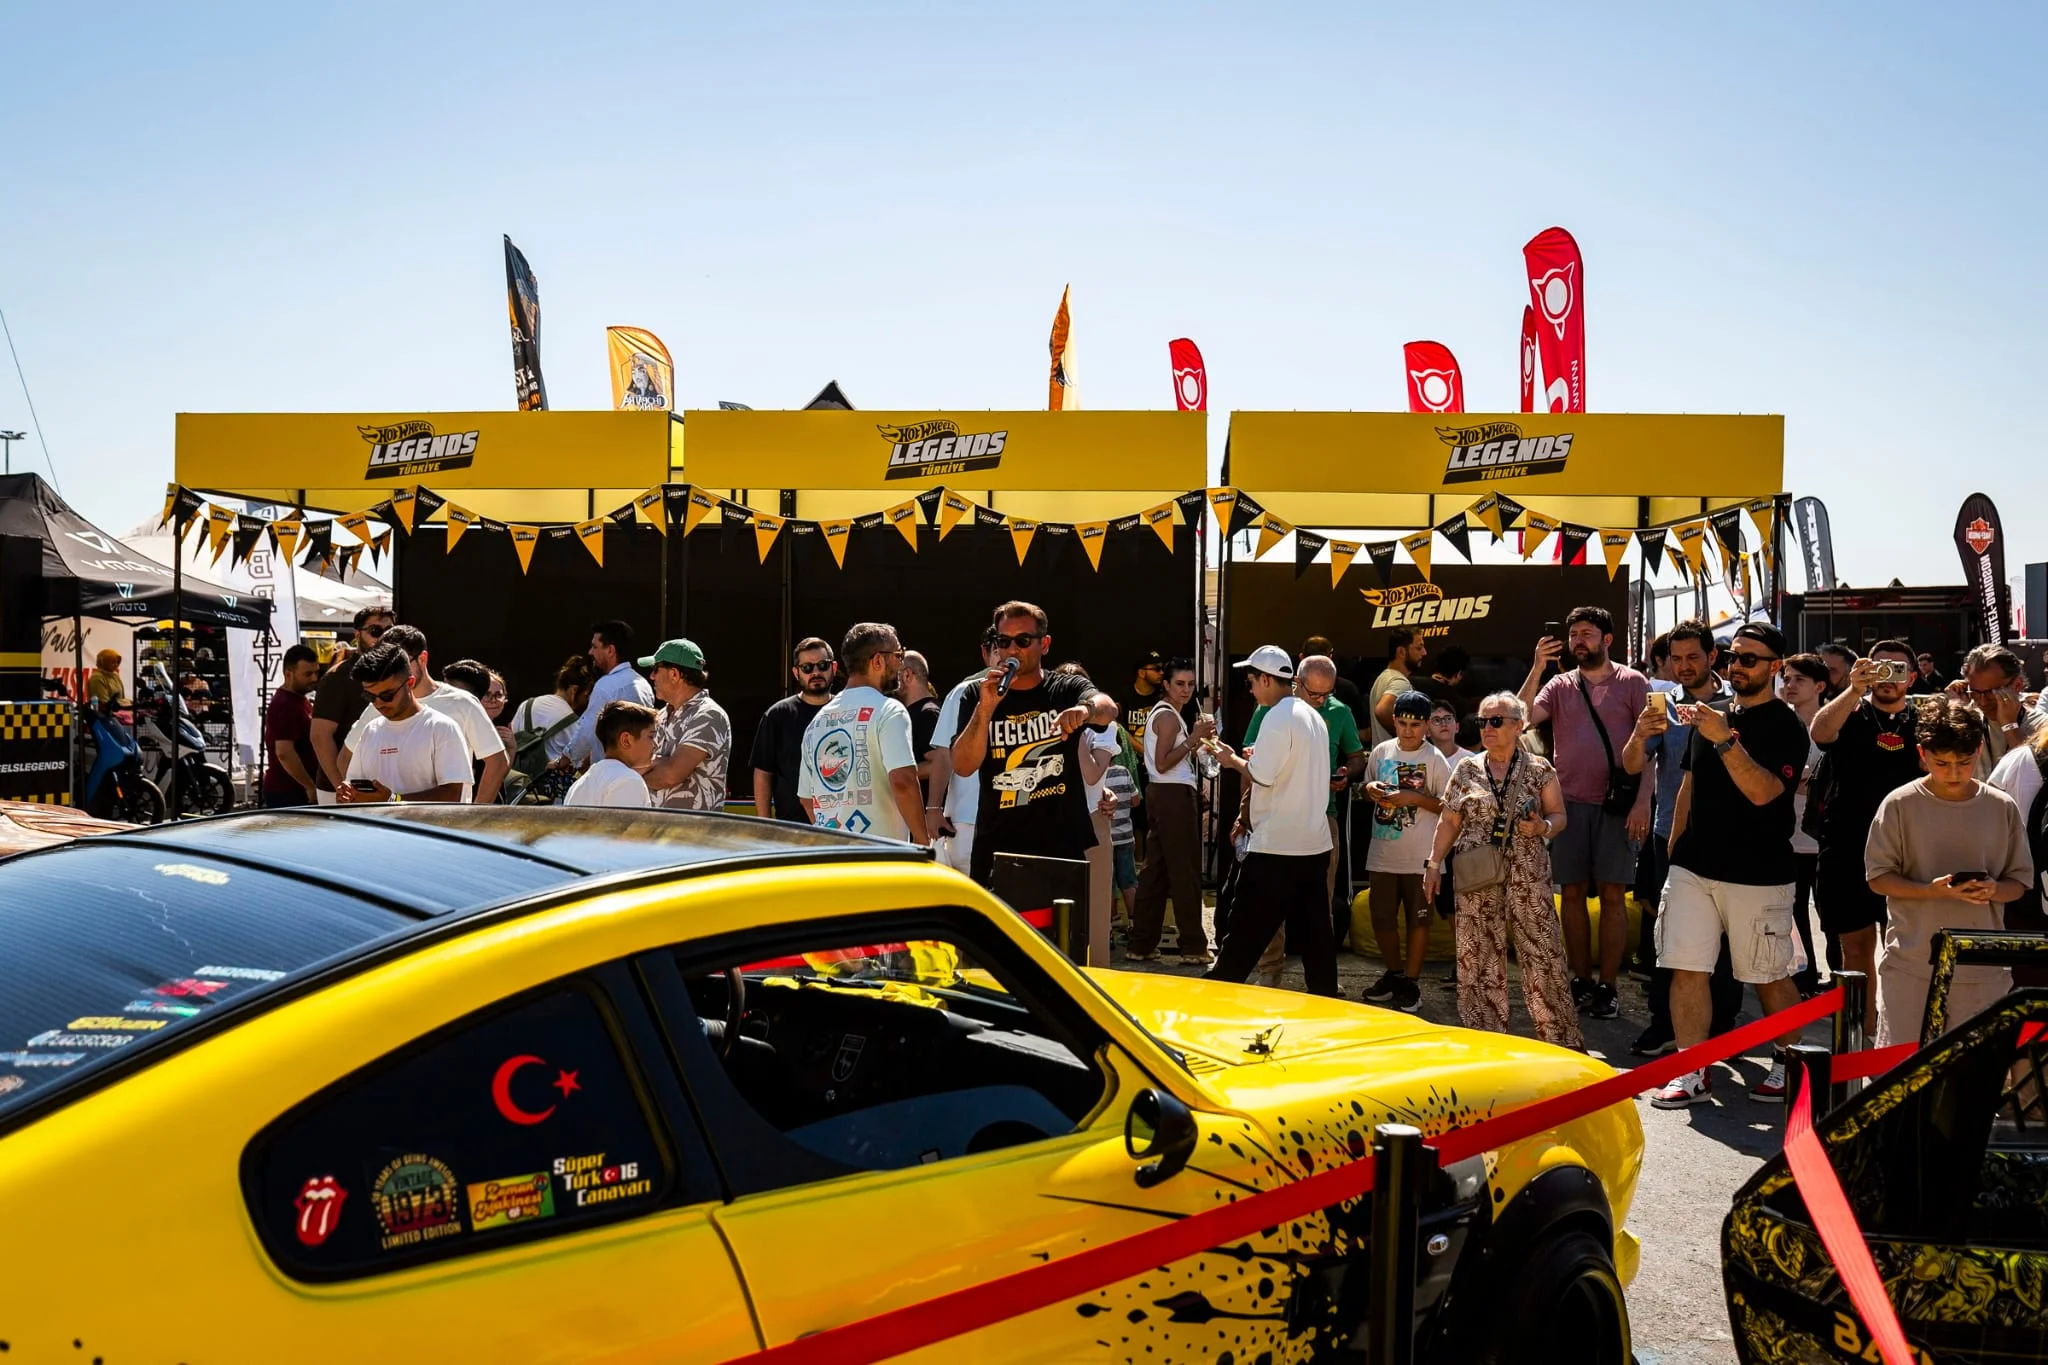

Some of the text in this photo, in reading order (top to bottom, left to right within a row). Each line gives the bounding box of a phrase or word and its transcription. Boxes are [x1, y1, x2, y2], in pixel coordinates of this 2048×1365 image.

[370, 431, 480, 466] LEGENDS
[890, 431, 1008, 466] LEGENDS
[1448, 433, 1574, 469] LEGENDS
[399, 461, 441, 475] TÜRKİYE
[921, 461, 966, 476] TÜRKİYE
[1481, 465, 1529, 480] TÜRKİYE
[1238, 500, 1260, 515] LEGENDS
[1118, 519, 1139, 531] LEGENDS
[1299, 537, 1322, 548] LEGENDS
[1371, 594, 1493, 629] LEGENDS
[1421, 625, 1450, 638] KİYE
[0, 761, 66, 774] ELSLEGENDS
[553, 1152, 606, 1175] Süper
[563, 1162, 638, 1191] Türk 16
[576, 1179, 651, 1207] Canavarı
[392, 1186, 446, 1226] 1973
[382, 1221, 461, 1250] LIMITED EDITION
